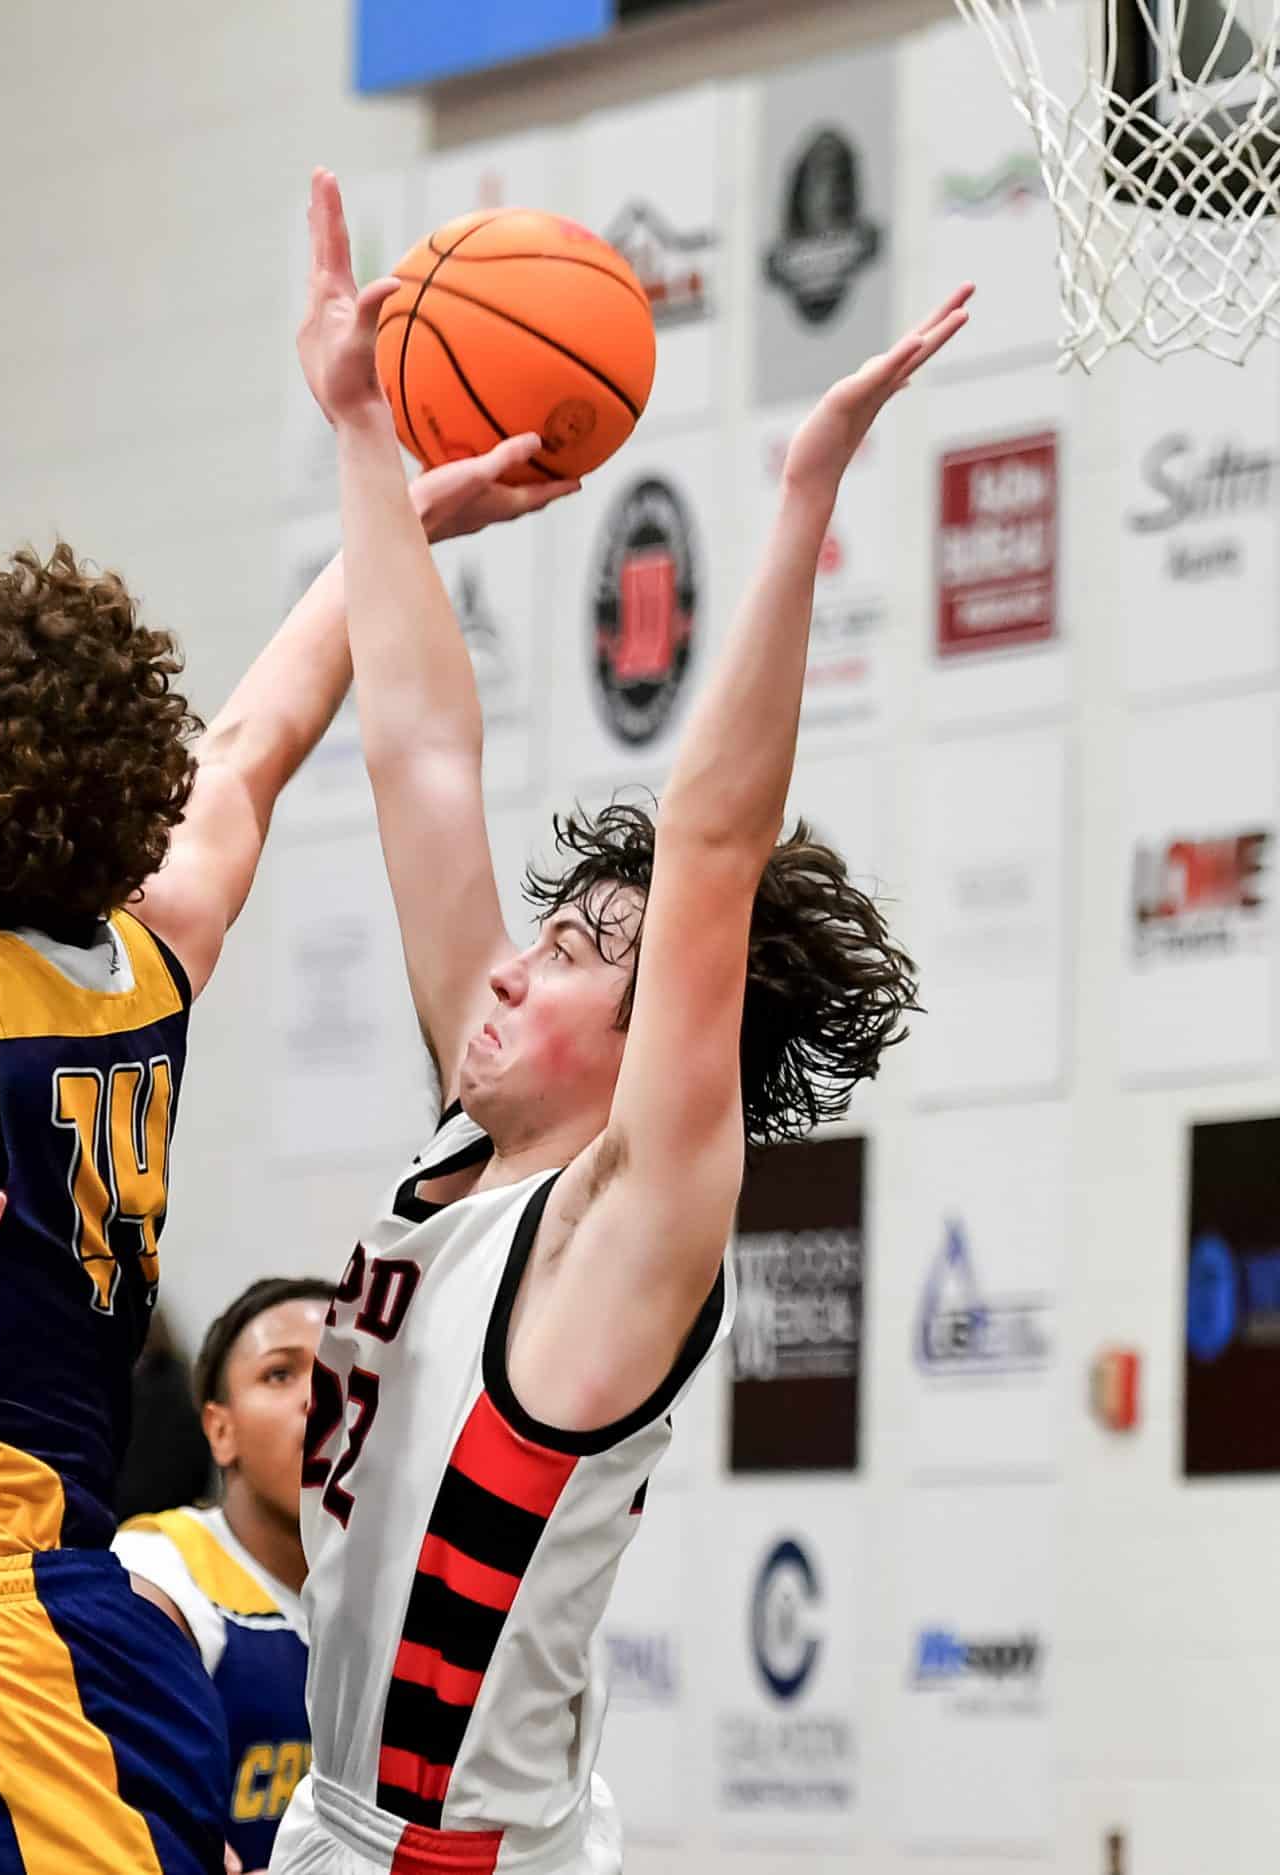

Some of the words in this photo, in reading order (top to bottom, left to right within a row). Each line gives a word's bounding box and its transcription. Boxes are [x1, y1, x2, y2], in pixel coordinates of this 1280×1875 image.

[51, 1054, 173, 1315] 14
[302, 1355, 380, 1531] 22
[230, 1742, 312, 1822] CA
